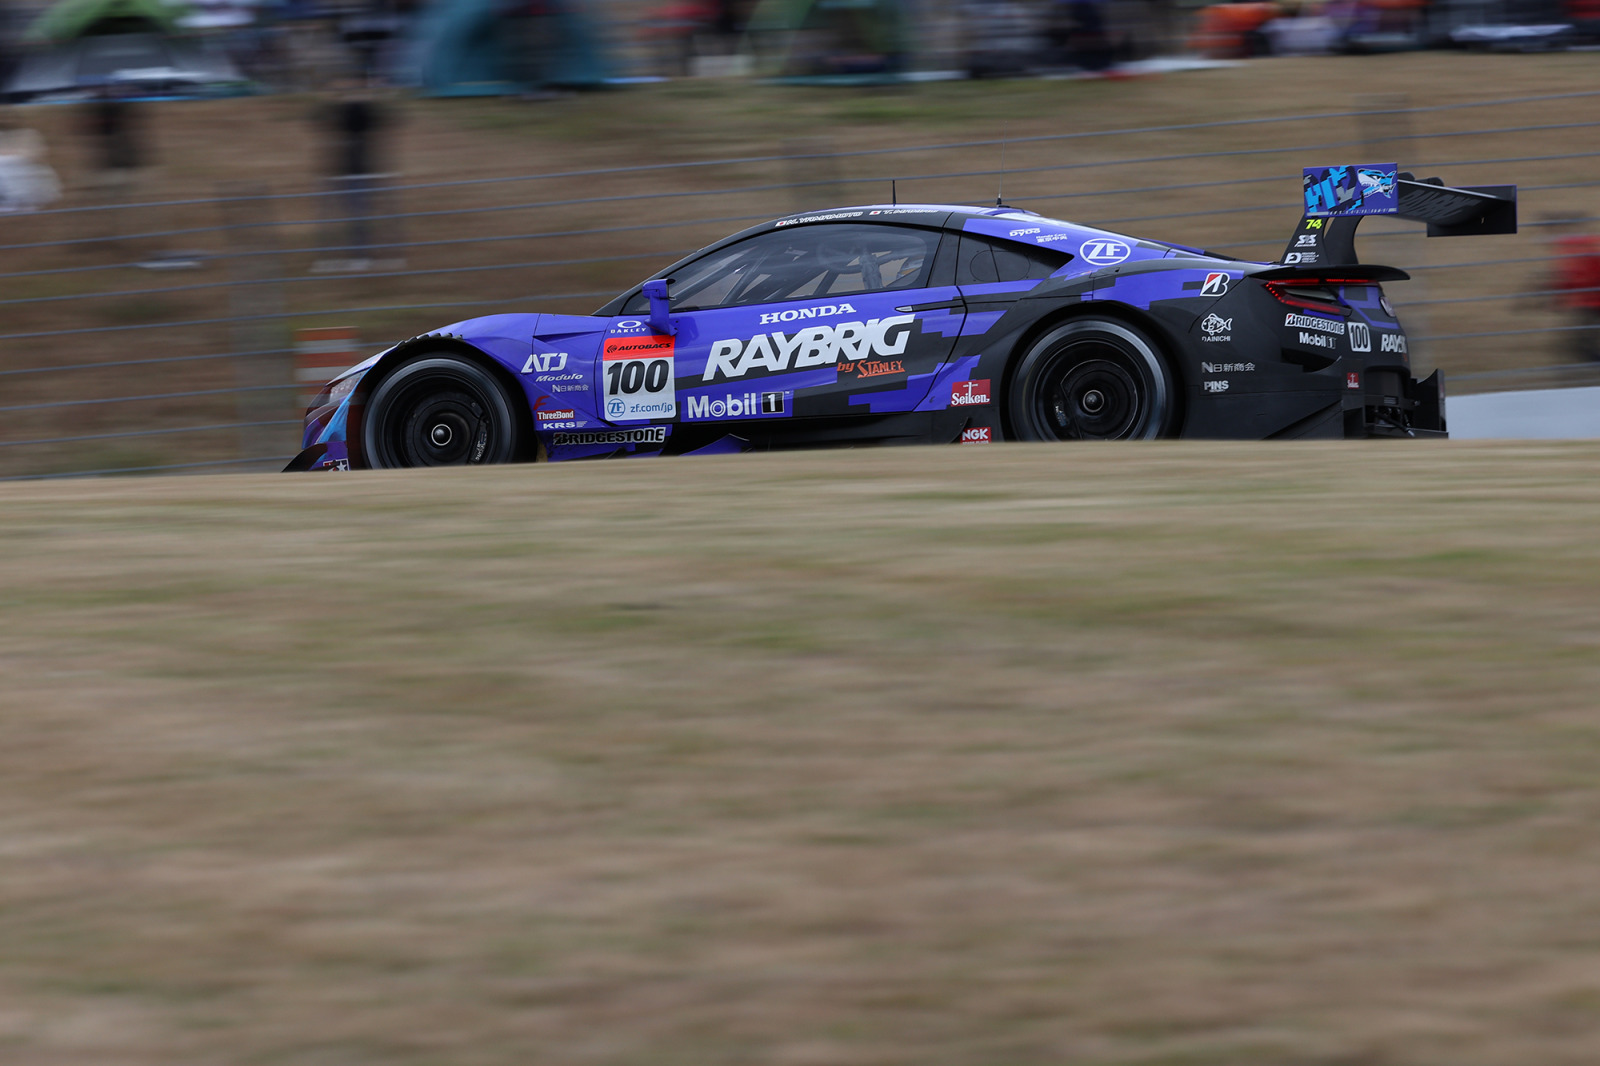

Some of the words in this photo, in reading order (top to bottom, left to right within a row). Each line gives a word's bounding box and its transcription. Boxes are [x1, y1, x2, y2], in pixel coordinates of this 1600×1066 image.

[1305, 219, 1323, 230] 74
[1084, 242, 1126, 260] ZF
[760, 303, 856, 325] HONDA
[1285, 313, 1345, 335] BRIDGESTONE
[1299, 331, 1327, 347] Mobil
[1351, 324, 1369, 349] 100
[618, 342, 671, 352] AUTOBACS
[702, 314, 915, 382] RAYBRIG
[535, 373, 584, 383] Modulo
[607, 359, 669, 396] 100
[837, 362, 855, 373] by
[857, 360, 906, 379] STANLEY
[1203, 380, 1230, 391] PINS
[609, 400, 624, 415] ZF
[630, 402, 674, 414] zf.com/jp
[687, 392, 757, 419] Mobil
[537, 410, 574, 421] ThreeBond
[543, 421, 576, 429] KRS
[553, 427, 666, 446] BRIDGESTONE
[962, 428, 989, 441] NGK
